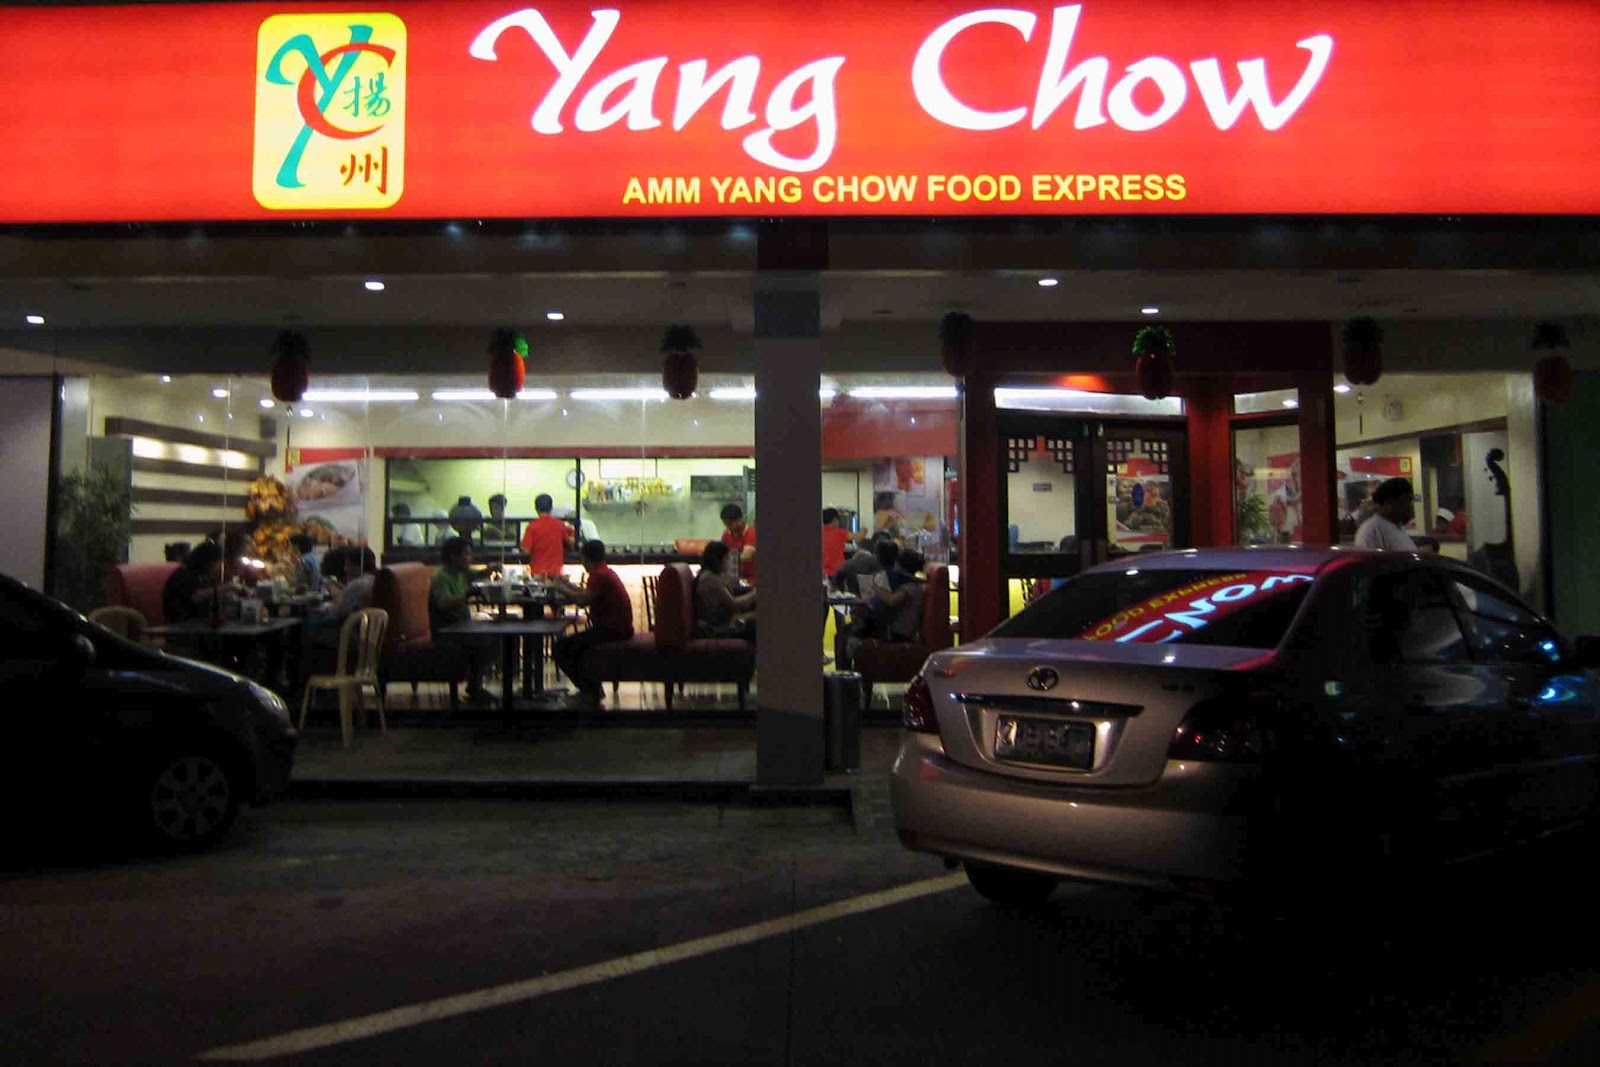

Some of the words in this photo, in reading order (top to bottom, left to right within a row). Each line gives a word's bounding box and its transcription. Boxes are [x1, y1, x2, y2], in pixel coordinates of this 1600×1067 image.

[470, 8, 846, 173] Yang
[911, 4, 1334, 132] Chow
[622, 176, 701, 205] AMM
[709, 175, 803, 204] YANG
[812, 174, 919, 203] CHOW
[926, 174, 1022, 202] FOOD
[1031, 173, 1187, 202] EXPRESS
